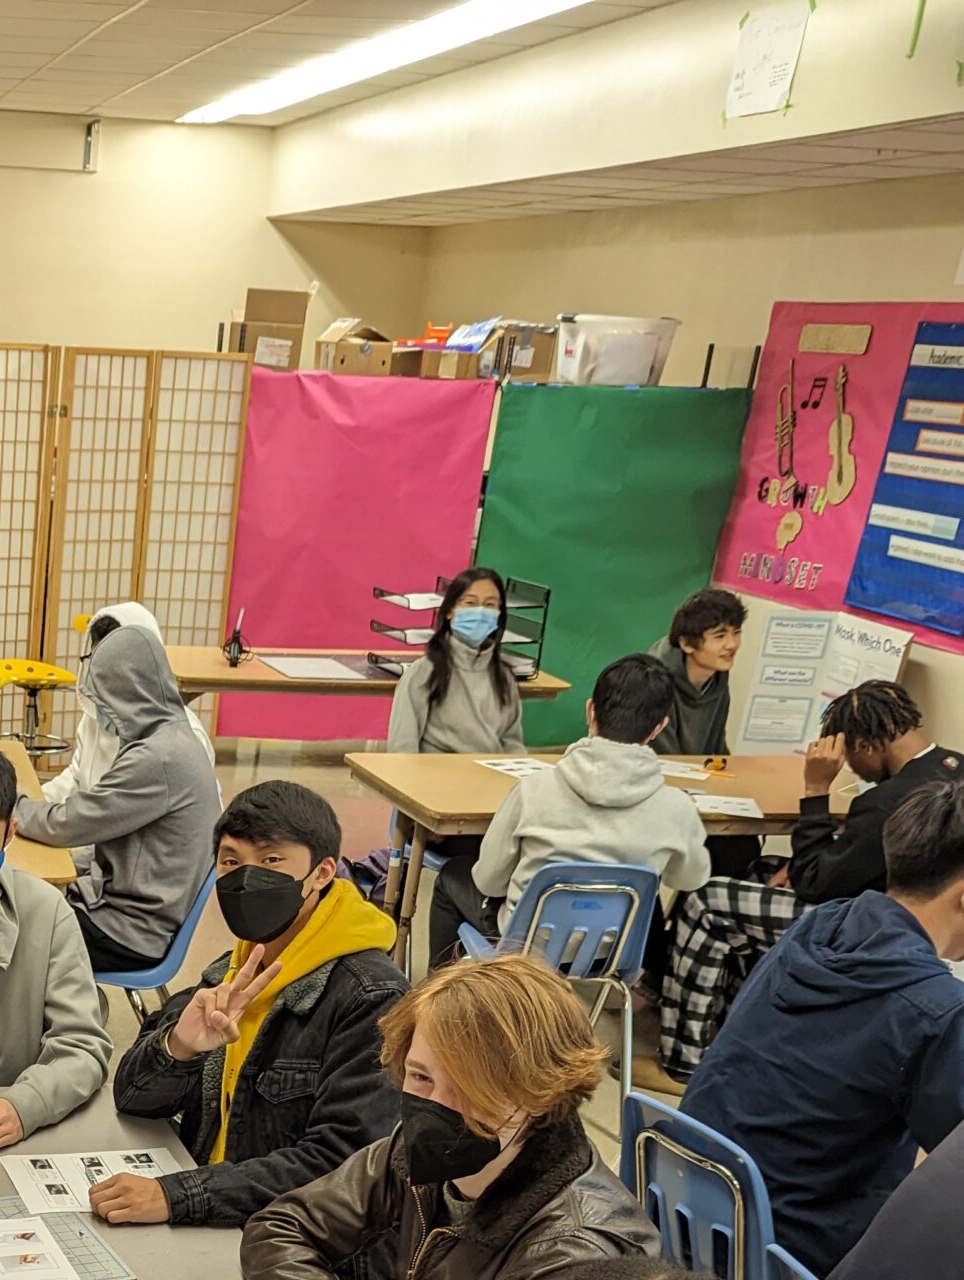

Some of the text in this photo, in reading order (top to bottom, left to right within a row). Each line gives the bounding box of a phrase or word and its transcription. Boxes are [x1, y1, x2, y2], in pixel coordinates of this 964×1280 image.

[758, 477, 826, 516] GROWTH
[739, 552, 824, 591] MINDSET
[857, 629, 881, 651] Which
